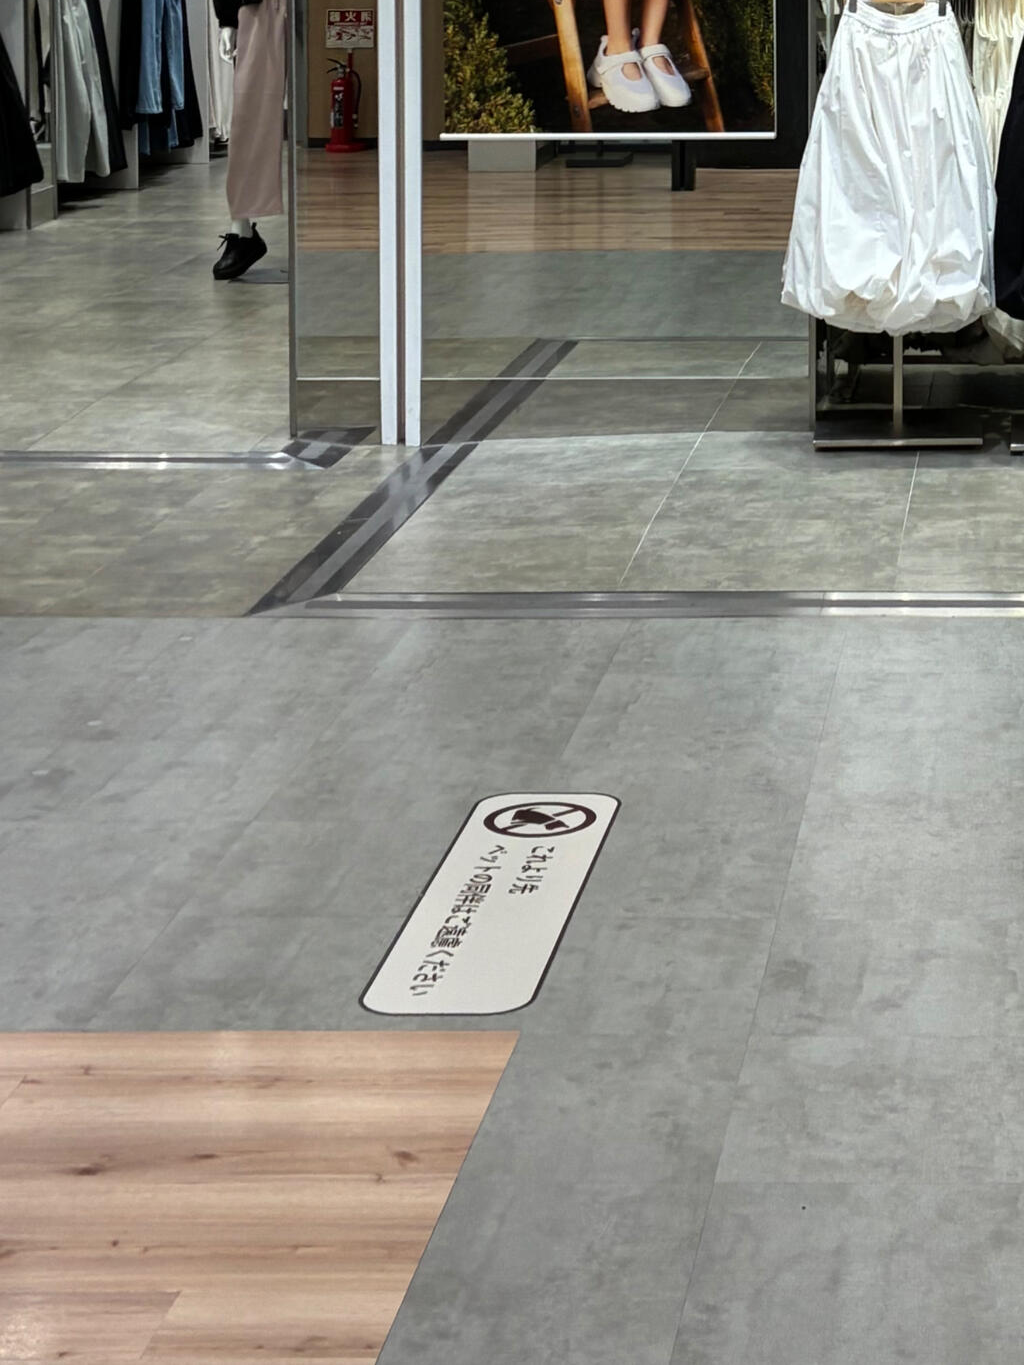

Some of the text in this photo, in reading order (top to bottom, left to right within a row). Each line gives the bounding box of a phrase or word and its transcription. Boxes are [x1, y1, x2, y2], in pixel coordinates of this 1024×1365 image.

[409, 844, 508, 996] ペットの同伴はご遠慮ください
[508, 845, 555, 895] これより先
